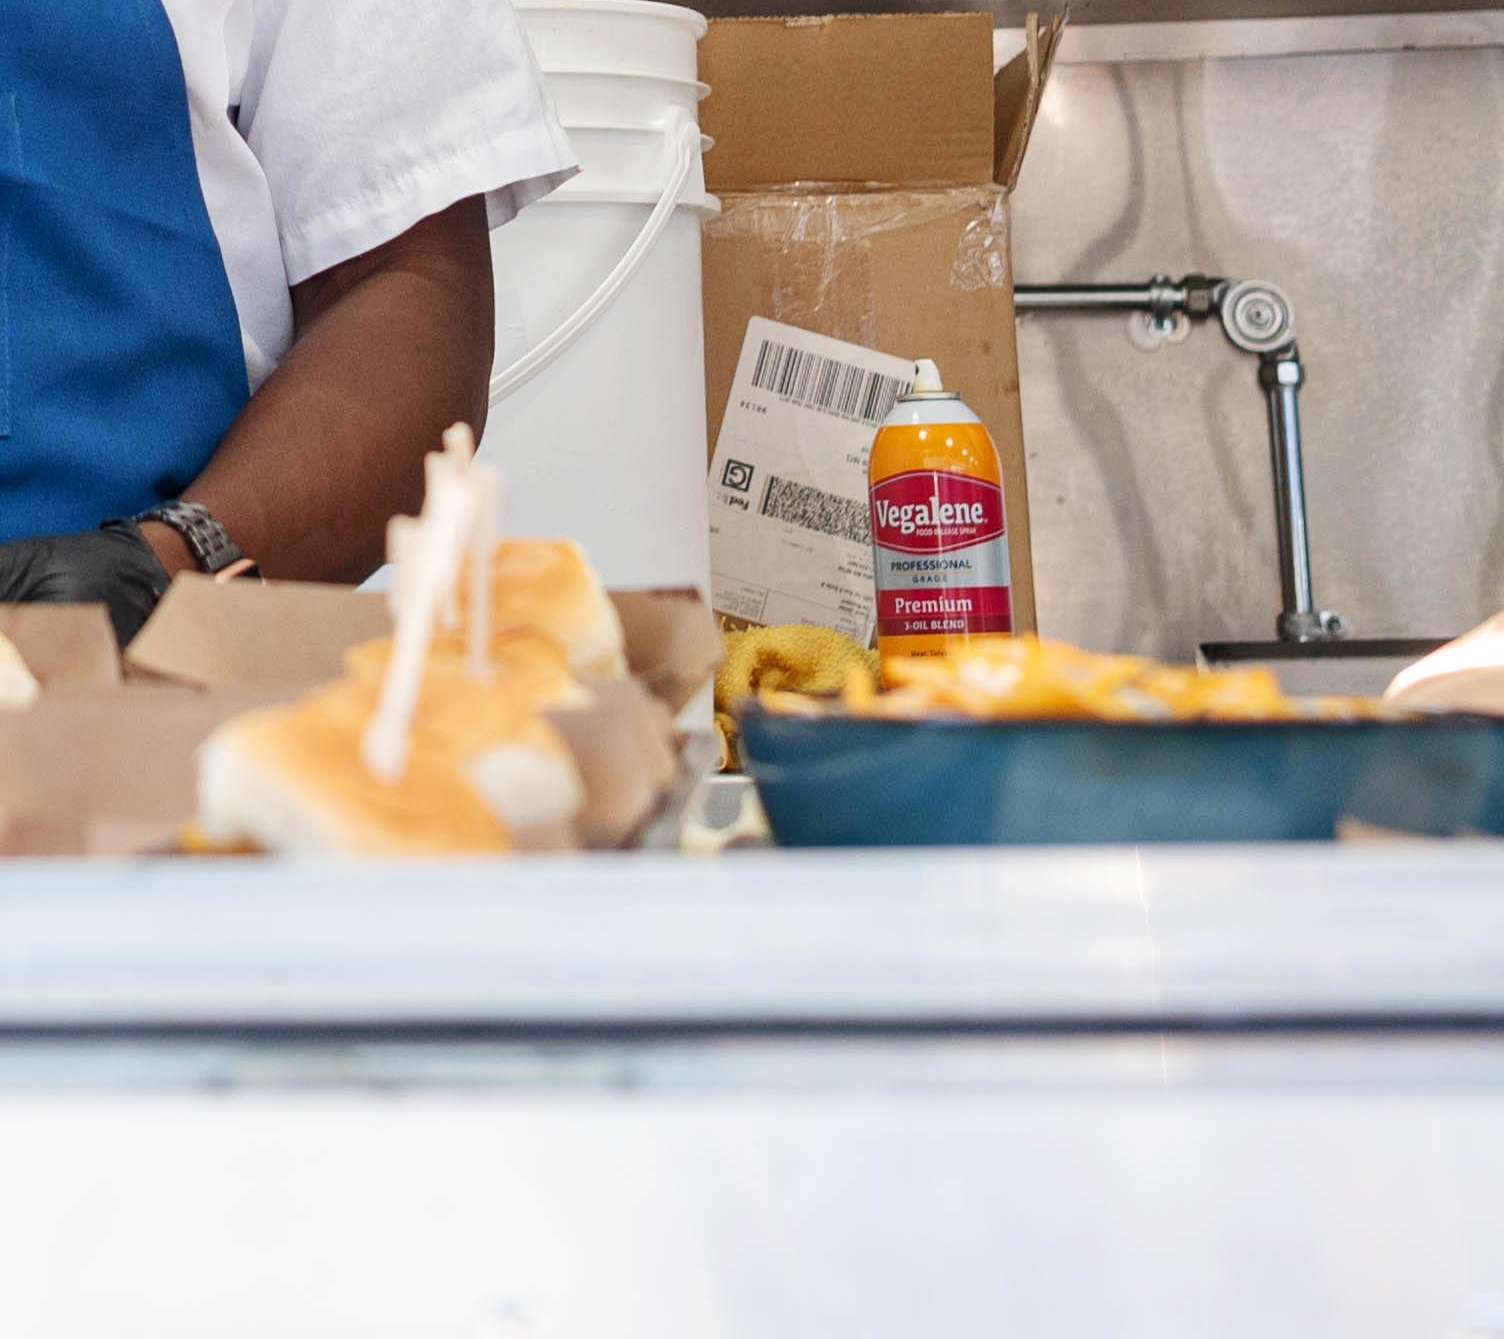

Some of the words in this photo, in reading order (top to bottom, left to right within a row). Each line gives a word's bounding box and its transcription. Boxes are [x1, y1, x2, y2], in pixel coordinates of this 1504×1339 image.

[876, 495, 984, 535] Vegalene
[916, 527, 932, 537] FOOD
[891, 559, 973, 572] PROFESSIONAL
[912, 574, 949, 584] GRADE
[895, 595, 973, 614] Premium
[904, 620, 929, 631] 3-OIL
[931, 619, 965, 630] BLEND
